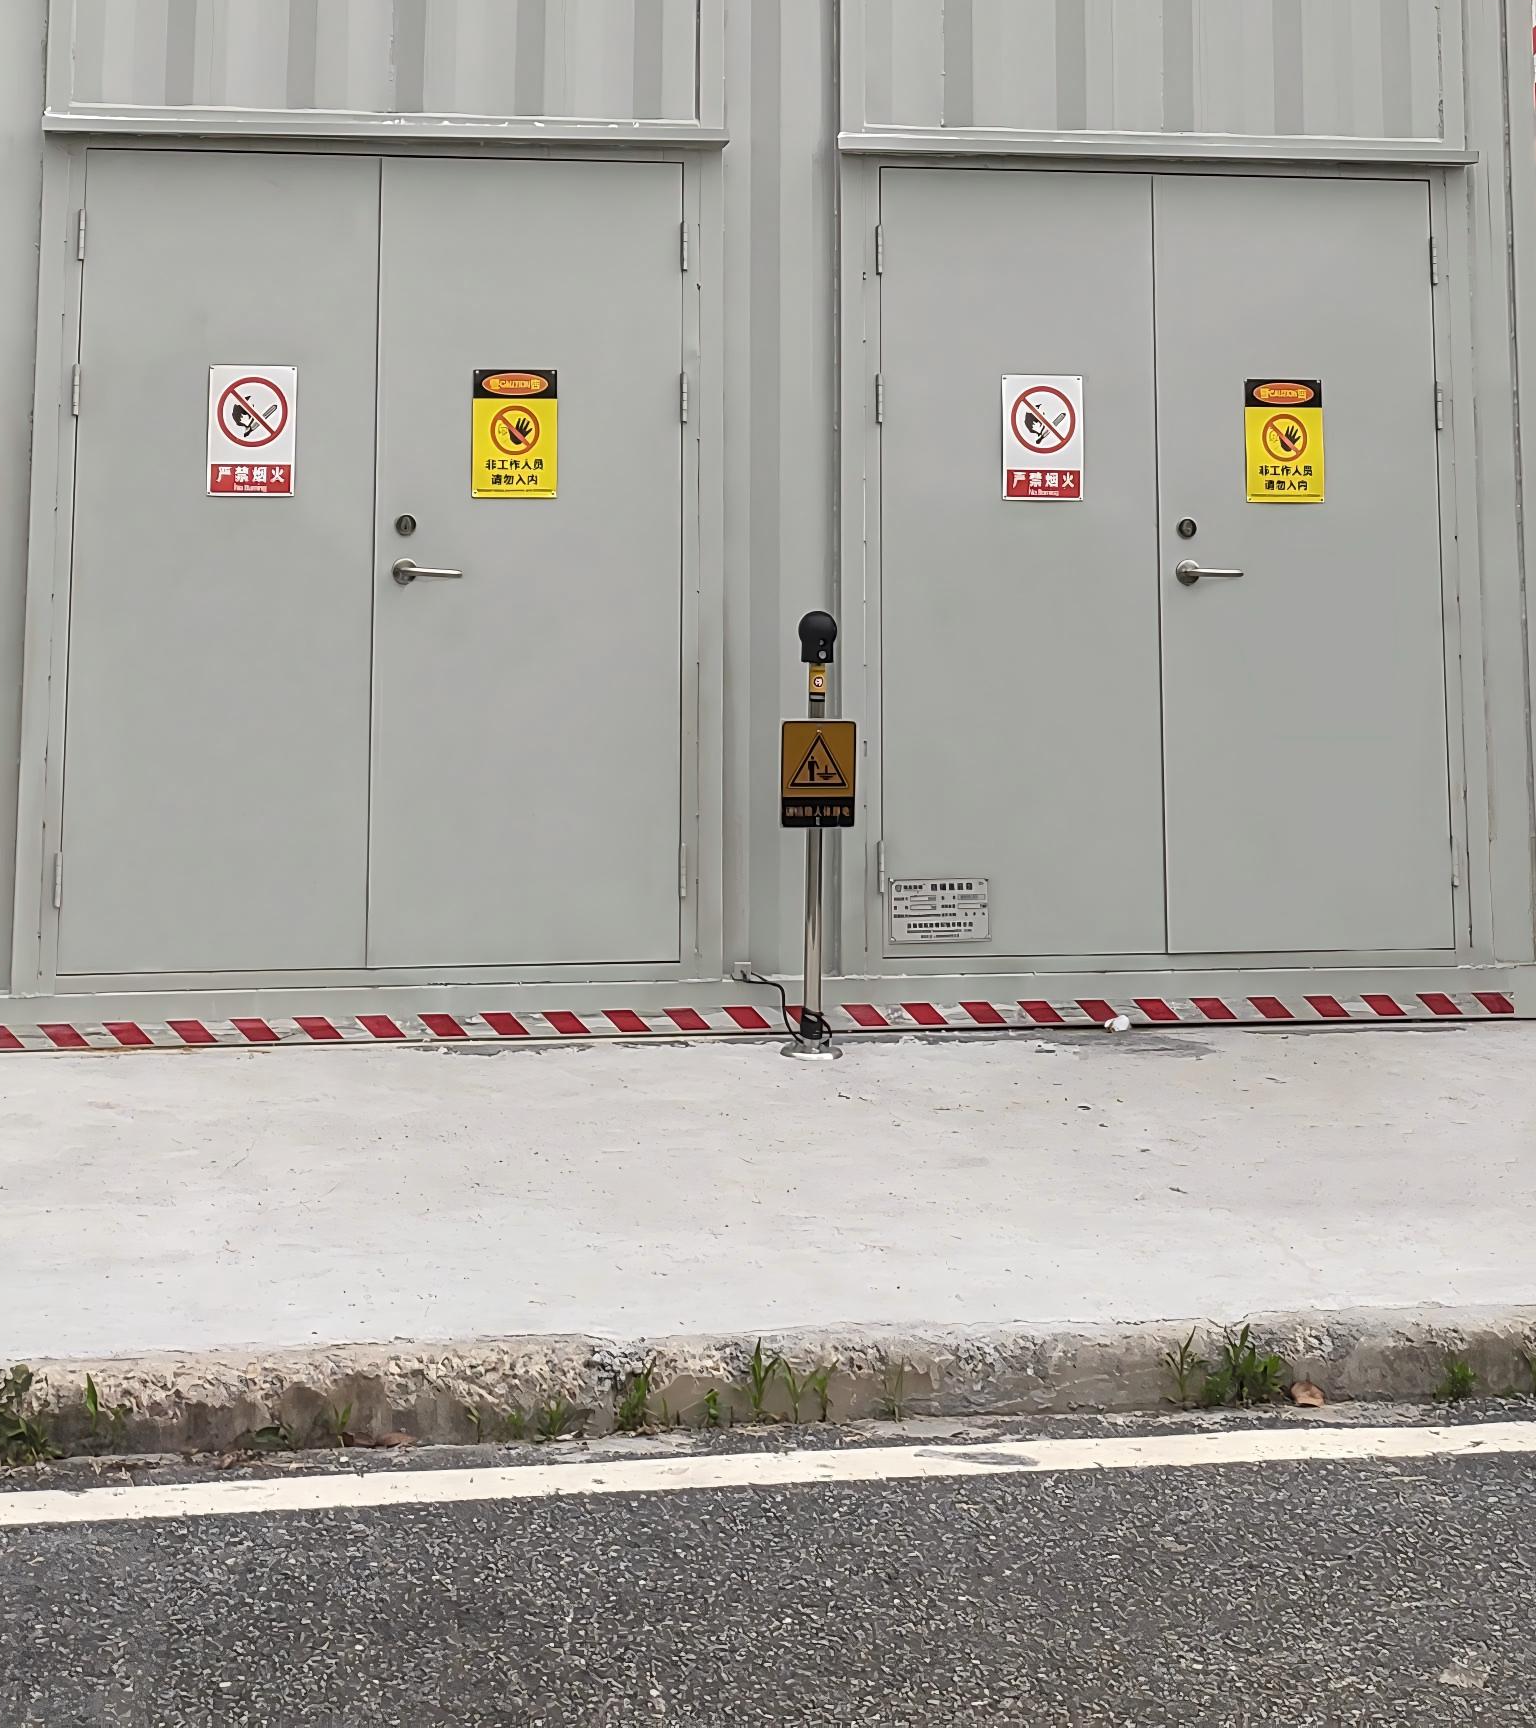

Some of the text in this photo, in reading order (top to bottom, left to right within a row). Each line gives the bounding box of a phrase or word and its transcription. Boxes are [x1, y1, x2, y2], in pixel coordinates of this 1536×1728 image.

[485, 459, 544, 470] 非工作人员
[215, 466, 285, 483] 严禁烟火
[1259, 465, 1313, 477] 非工作人员
[491, 474, 538, 485] 请勿入内
[1012, 471, 1075, 488] 严禁烟火
[1265, 479, 1308, 491] 请勿入内
